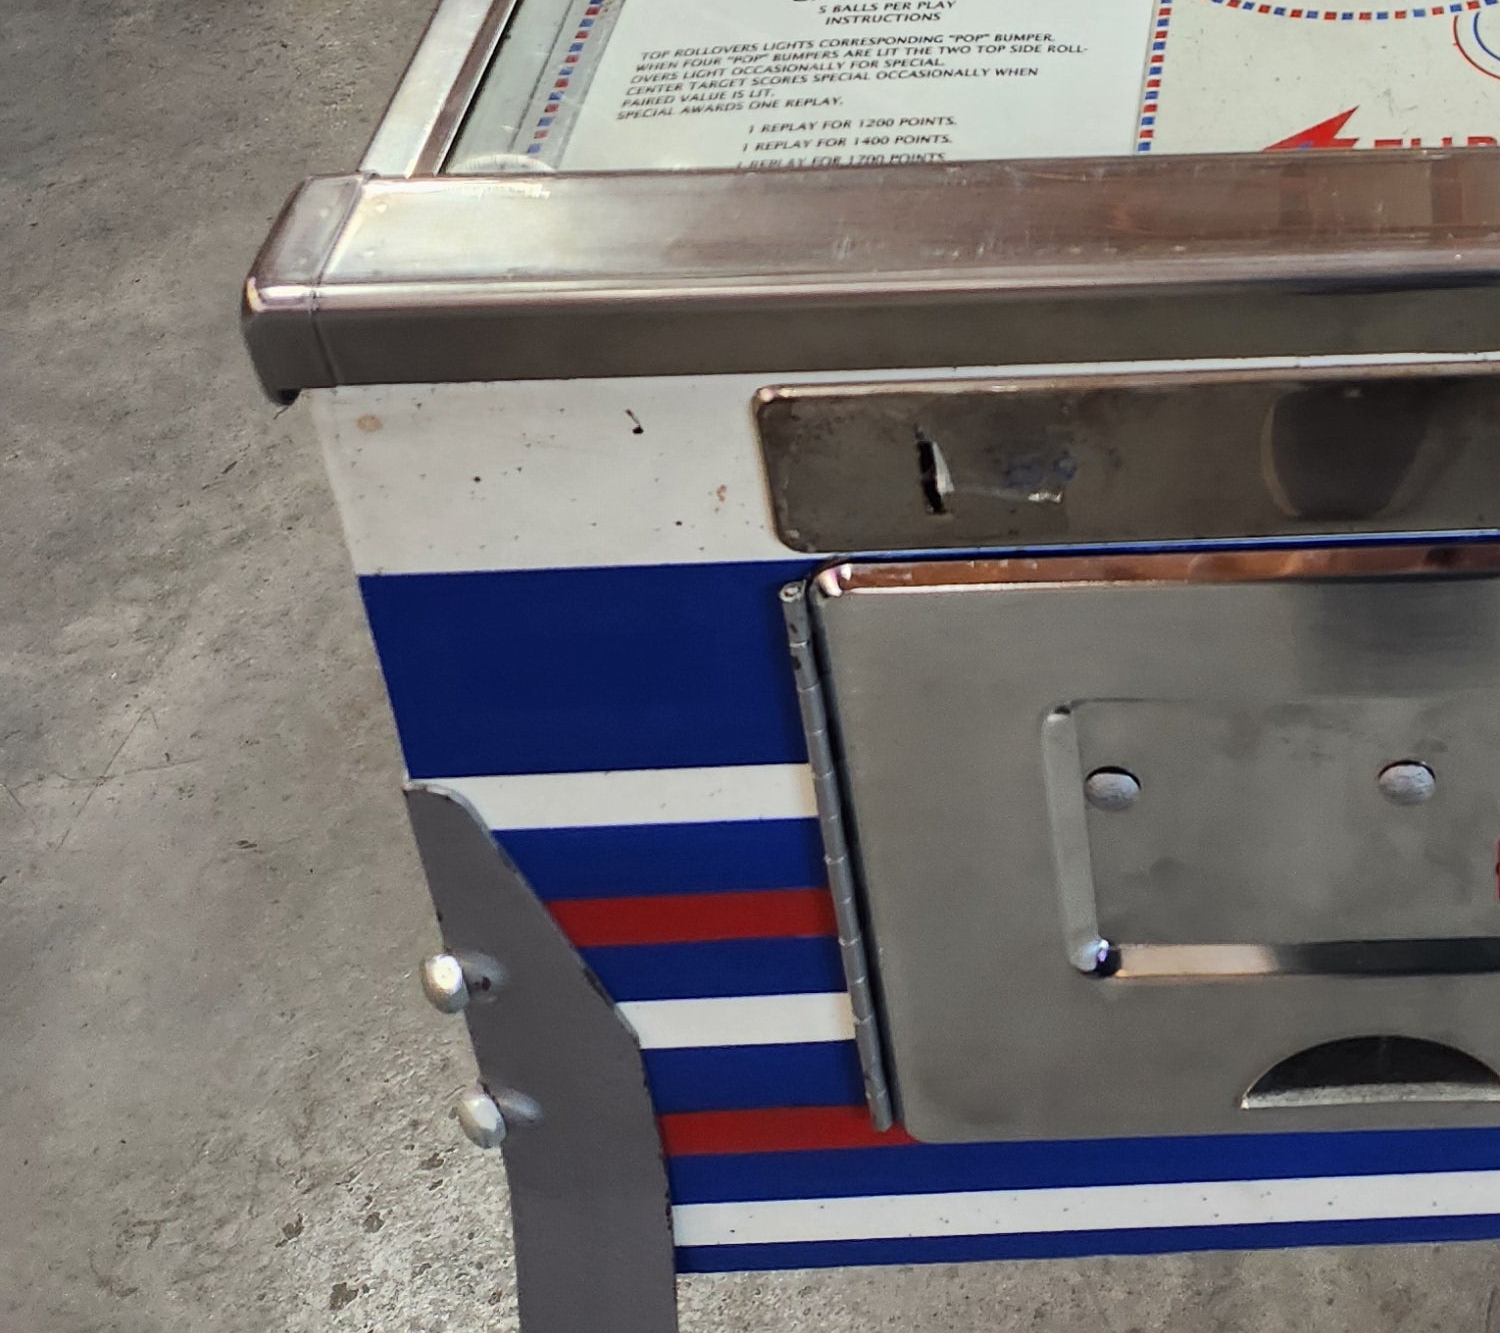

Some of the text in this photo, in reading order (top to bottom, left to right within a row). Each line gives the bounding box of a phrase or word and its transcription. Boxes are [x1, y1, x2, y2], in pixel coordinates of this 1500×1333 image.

[832, 0, 957, 14] BALLS PER PLAY
[825, 12, 942, 25] INSTRUCTIONS
[674, 34, 944, 57] ROLLOVERS LIGHTS CORRESPONDING
[772, 44, 1043, 63] BUMPERS ARE THE TWO TOP SIDE
[631, 59, 880, 84] OVERS LIGHT OCCASIONALLY FOR
[626, 66, 1039, 96] CENTER TARGET SCORES SPECIAL OCCASIONALLY WHEN
[621, 91, 727, 108] PAIRED VALUE
[617, 101, 744, 121] SPECIAL AWARDS
[761, 118, 895, 133] REPLAY FOR 1200
[755, 136, 890, 151] REPLAY FOR 1400
